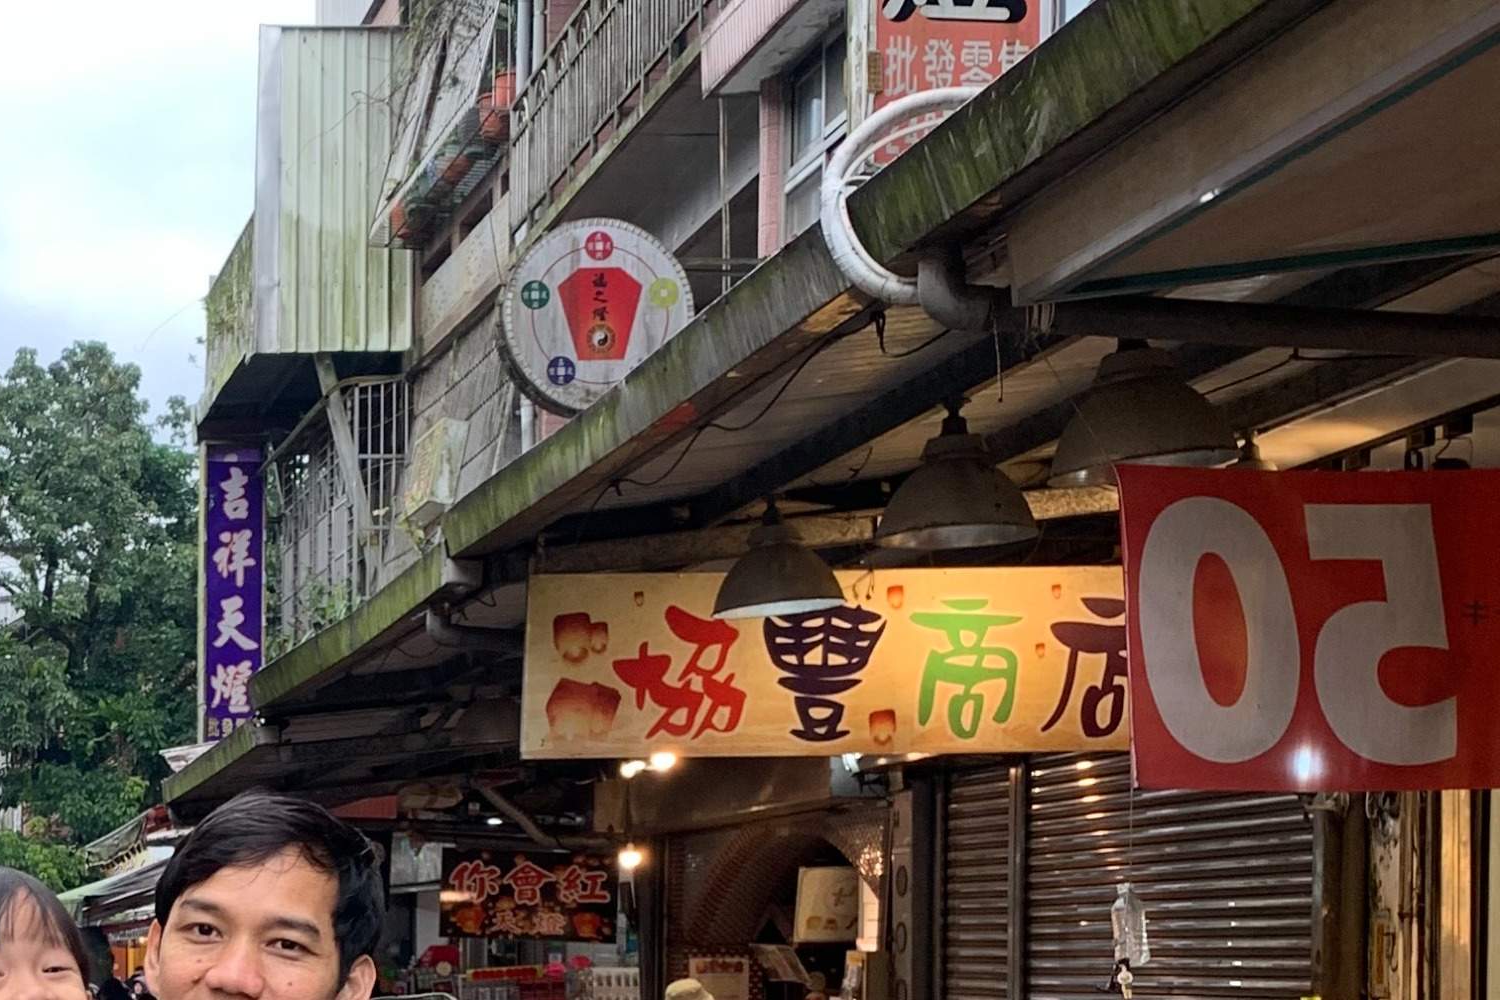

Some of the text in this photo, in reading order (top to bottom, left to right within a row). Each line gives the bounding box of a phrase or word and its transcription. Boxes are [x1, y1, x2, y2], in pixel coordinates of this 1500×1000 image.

[211, 466, 259, 713] 吉祥天燈
[449, 860, 611, 905] 你會紅
